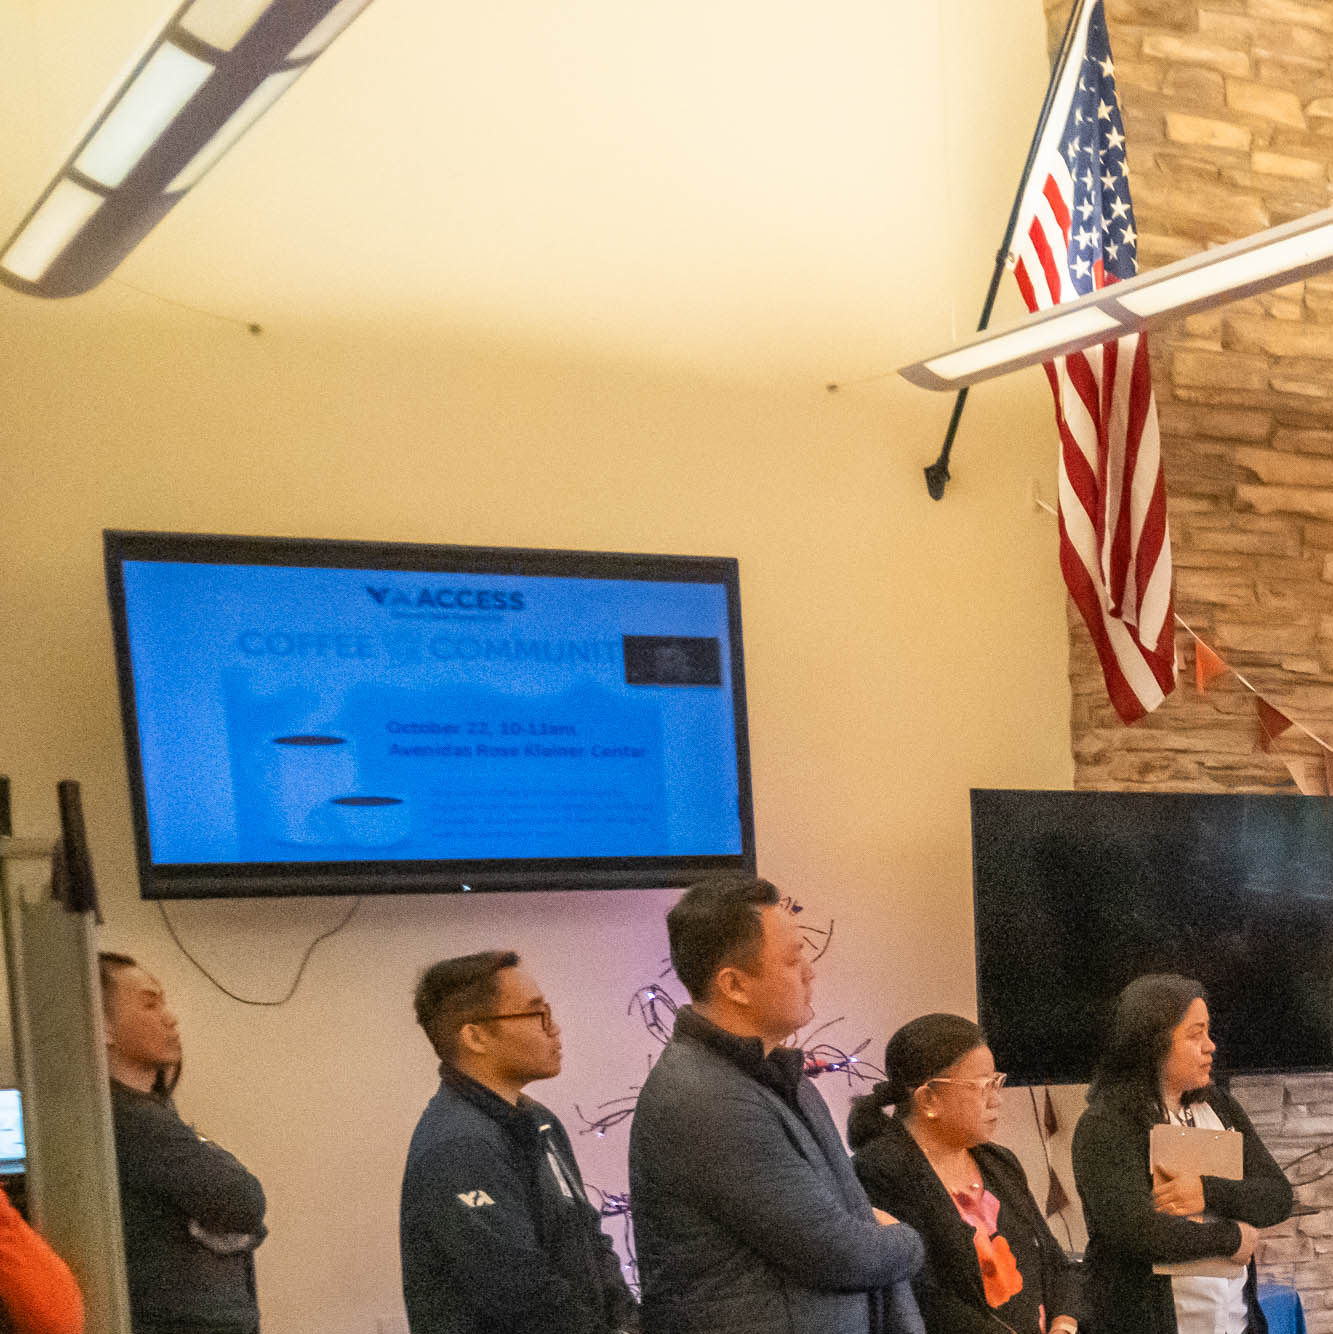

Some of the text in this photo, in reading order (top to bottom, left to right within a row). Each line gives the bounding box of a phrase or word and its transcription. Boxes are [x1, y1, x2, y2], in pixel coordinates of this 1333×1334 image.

[417, 588, 525, 610] ACCESS
[238, 632, 373, 659] COFFEE
[429, 636, 619, 663] COMMUNIT
[386, 720, 460, 735] October
[591, 744, 646, 758] Center
